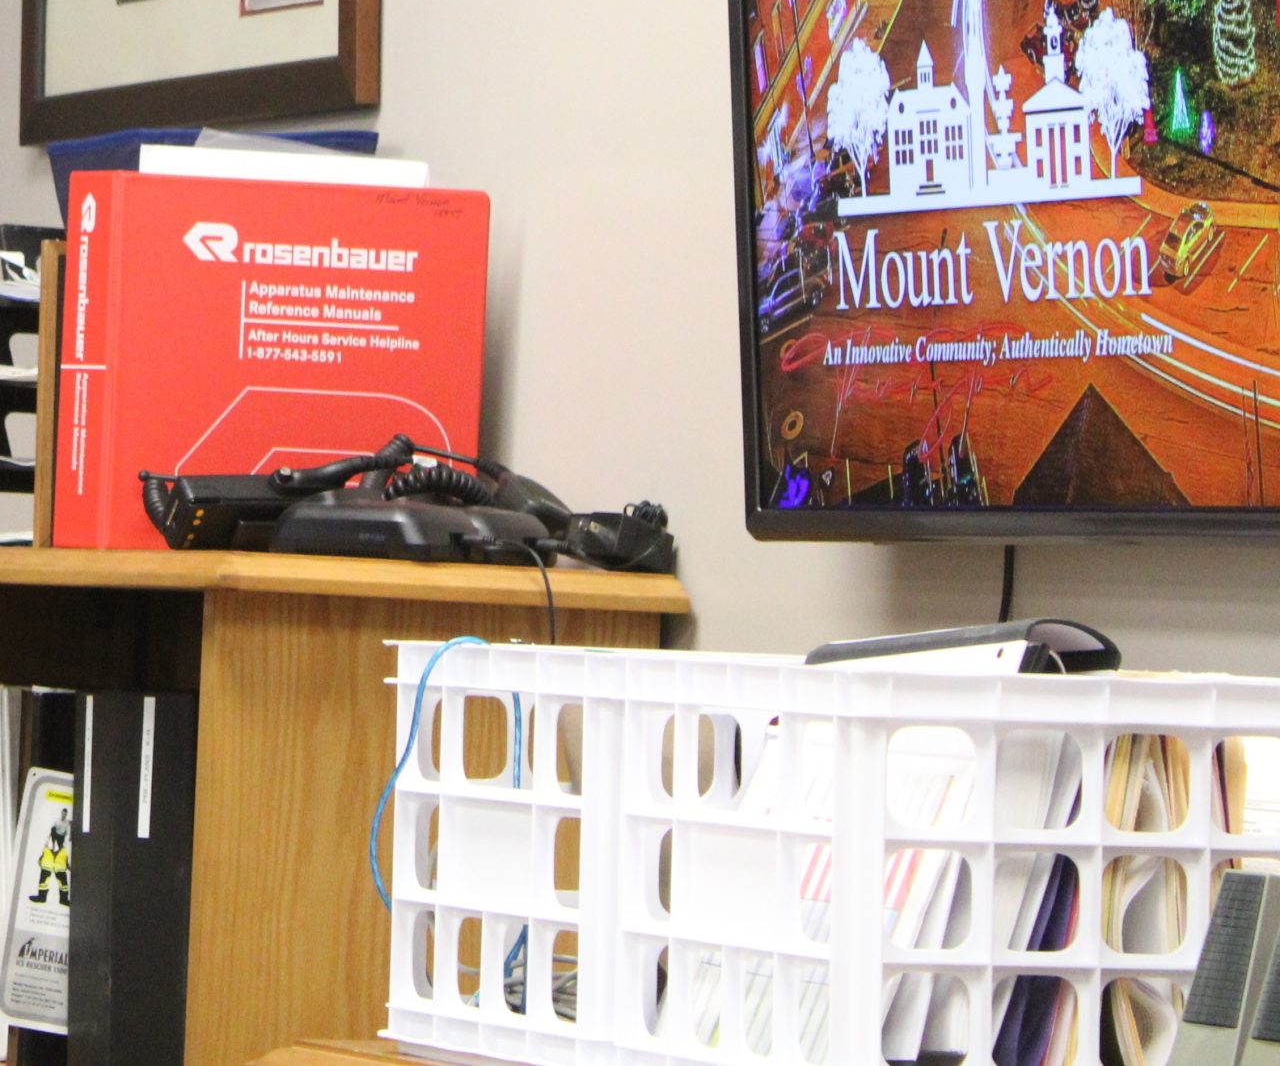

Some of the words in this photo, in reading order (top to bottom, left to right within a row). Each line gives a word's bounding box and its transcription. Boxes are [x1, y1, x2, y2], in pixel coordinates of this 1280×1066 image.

[242, 237, 419, 273] rosenbauer
[834, 228, 974, 311] Mount
[983, 220, 1152, 304] Vernon
[75, 235, 89, 362] rosenbauer
[249, 280, 321, 300] Apparatus
[325, 284, 415, 304] Maintenance
[248, 300, 320, 319] Reference
[323, 304, 382, 322] Manuals
[248, 328, 279, 343] After
[281, 330, 319, 346] Hours
[321, 331, 367, 348] Service
[369, 336, 420, 351] Helpline
[823, 339, 843, 365] An
[845, 336, 912, 366] Innovative
[915, 334, 997, 366] Community;
[1000, 329, 1092, 362] Authentically
[1095, 329, 1173, 357] Hometown
[247, 346, 342, 364] 1-877-543-5591
